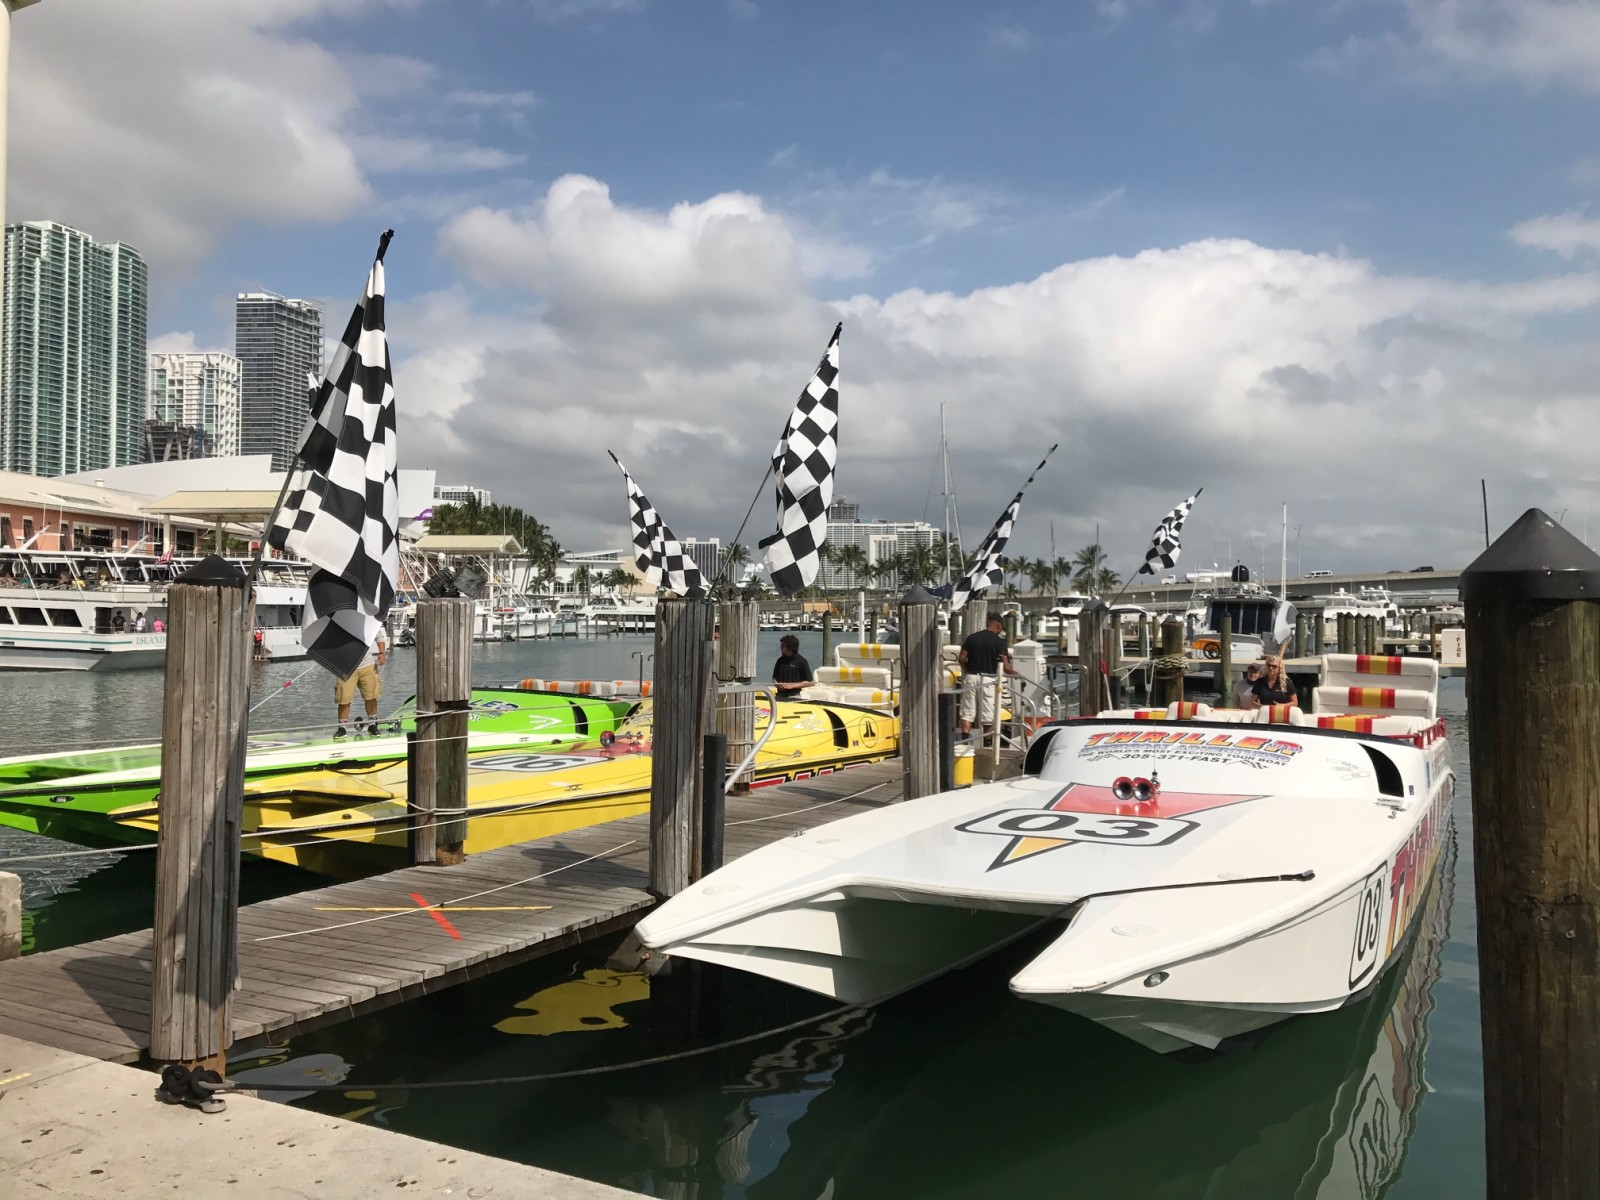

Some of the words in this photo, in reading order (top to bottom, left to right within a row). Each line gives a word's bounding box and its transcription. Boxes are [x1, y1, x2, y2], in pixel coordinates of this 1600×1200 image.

[136, 635, 166, 645] ISLAND
[1084, 731, 1303, 756] THRILLER
[1120, 753, 1232, 763] 305-371-FAST
[1227, 753, 1256, 761] TOUR
[1258, 757, 1288, 767] BOAT
[998, 813, 1160, 839] 03
[1357, 877, 1382, 962] 03
